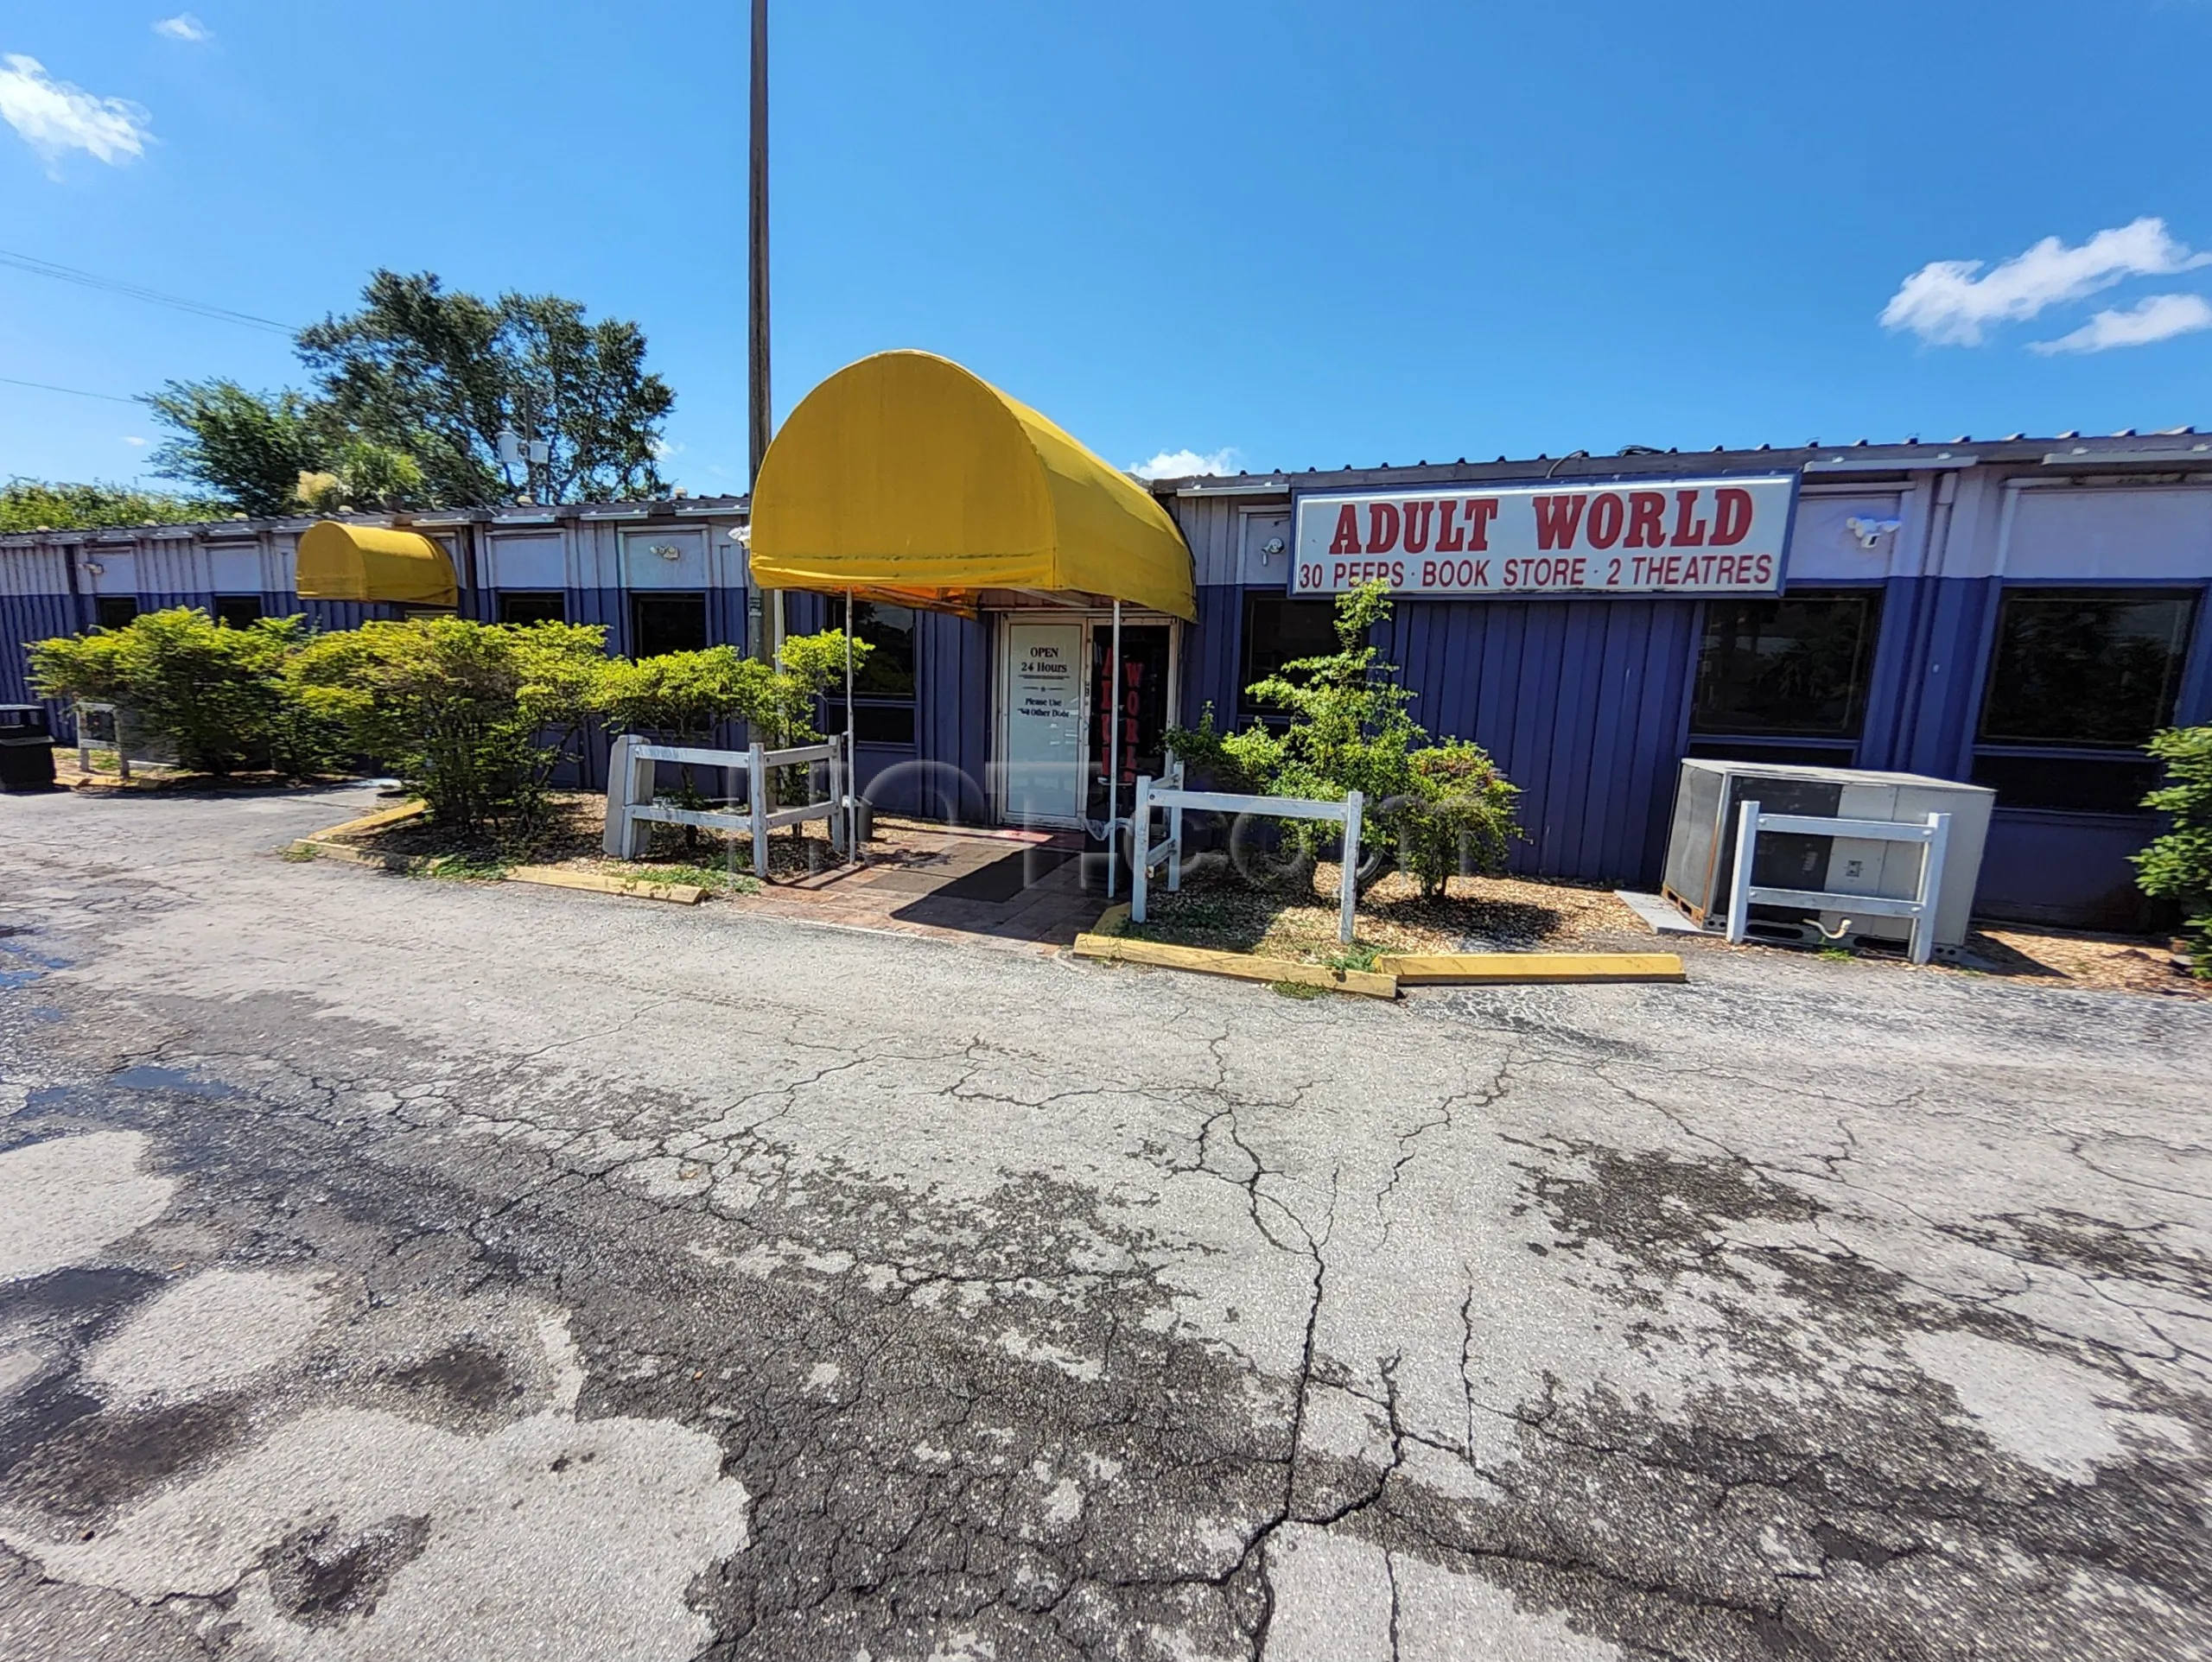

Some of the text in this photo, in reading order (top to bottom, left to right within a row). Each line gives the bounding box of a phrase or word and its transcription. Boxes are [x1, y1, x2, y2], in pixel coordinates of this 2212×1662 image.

[1329, 487, 1753, 555] ADULT WORLD
[1300, 554, 1772, 588] 30 PEEPS BOOK STORE 2 THEATRES
[1030, 646, 1058, 658] OPEN
[1020, 662, 1067, 673] 24 Hours
[1025, 697, 1062, 707] Please Use
[1030, 707, 1051, 717] Other
